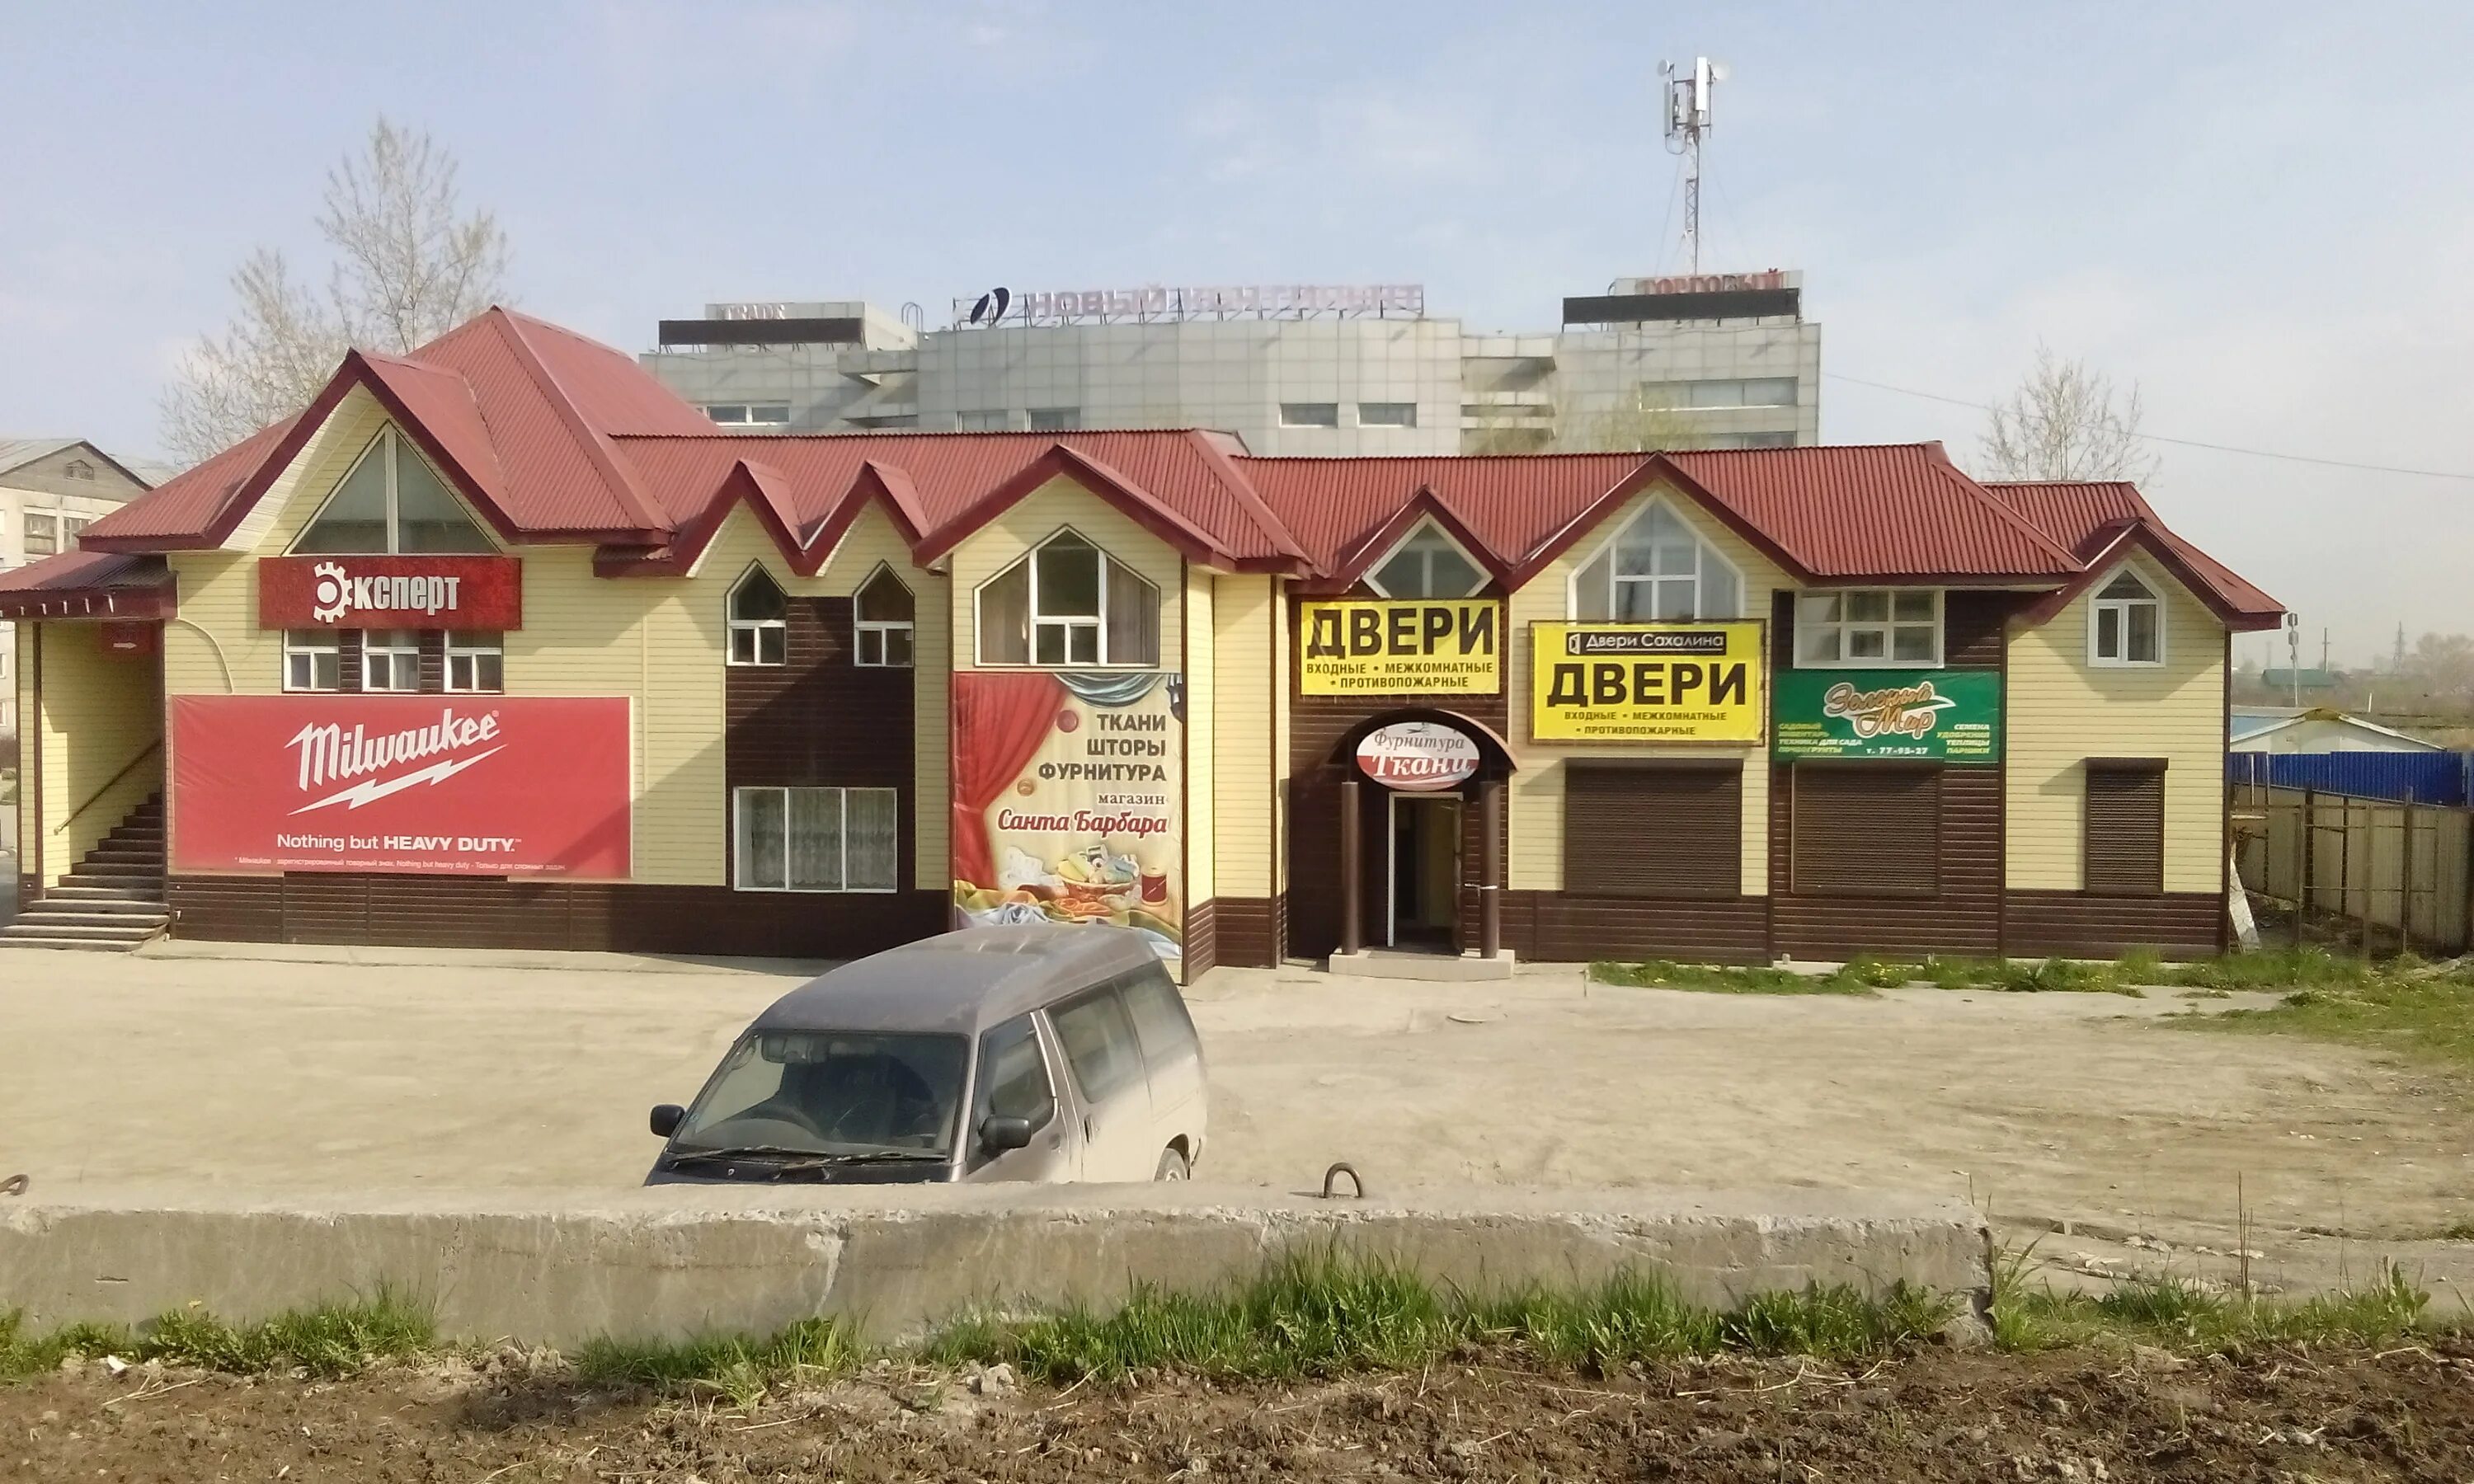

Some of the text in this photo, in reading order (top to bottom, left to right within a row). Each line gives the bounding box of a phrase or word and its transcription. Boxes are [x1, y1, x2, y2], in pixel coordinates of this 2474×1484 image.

[1032, 284, 1169, 317] НОВЫЙ
[313, 561, 460, 623] Эксперт
[1307, 607, 1493, 660] ДВЕРИ
[1587, 633, 1724, 649] Двери Сахалина
[1306, 663, 1493, 674] ВХОДНЫЕ МЕЖКОМНАТНЫЕ
[1340, 677, 1469, 688] ПРОТИВОПОЖАРНЫЕ
[1546, 663, 1746, 707] ДВЕРИ
[1097, 714, 1165, 731] ТКАНИ
[1564, 711, 1727, 721] ВХОДНЫЕ МЕЖКОМНАТНЫЕ
[1856, 707, 1935, 738] Мир
[1584, 726, 1696, 735] ПРОТИВОПОЖАРНЫЕ
[284, 708, 501, 791] Milwaukee
[1087, 740, 1165, 756] ШТОРЫ
[1374, 730, 1465, 752] Фурнитура
[1038, 763, 1166, 781] ФУРНИТУРА
[1371, 753, 1468, 777] Ткани
[1098, 794, 1164, 805] магазин
[998, 809, 1167, 838] Санта Барбара
[277, 834, 344, 852] Nothing
[350, 835, 379, 849] but
[383, 836, 452, 851] HEAVY
